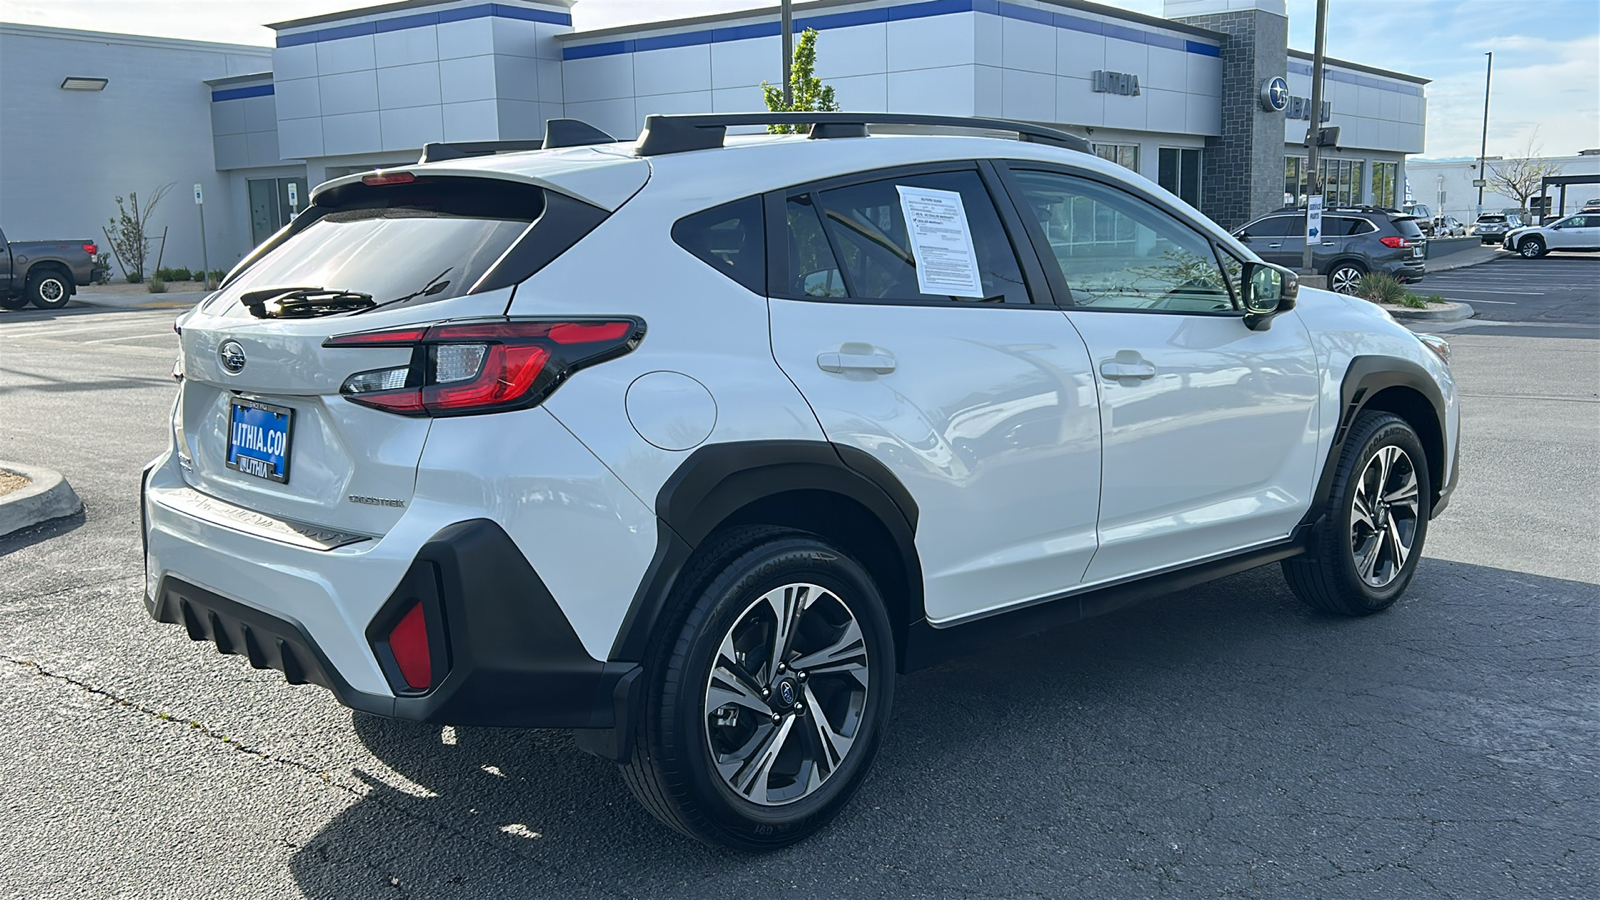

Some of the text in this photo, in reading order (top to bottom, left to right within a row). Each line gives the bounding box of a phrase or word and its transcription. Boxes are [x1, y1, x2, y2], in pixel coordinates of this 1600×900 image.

[1093, 70, 1141, 97] LITHIA
[1285, 96, 1331, 122] UBAU
[246, 458, 268, 478] LITHIA
